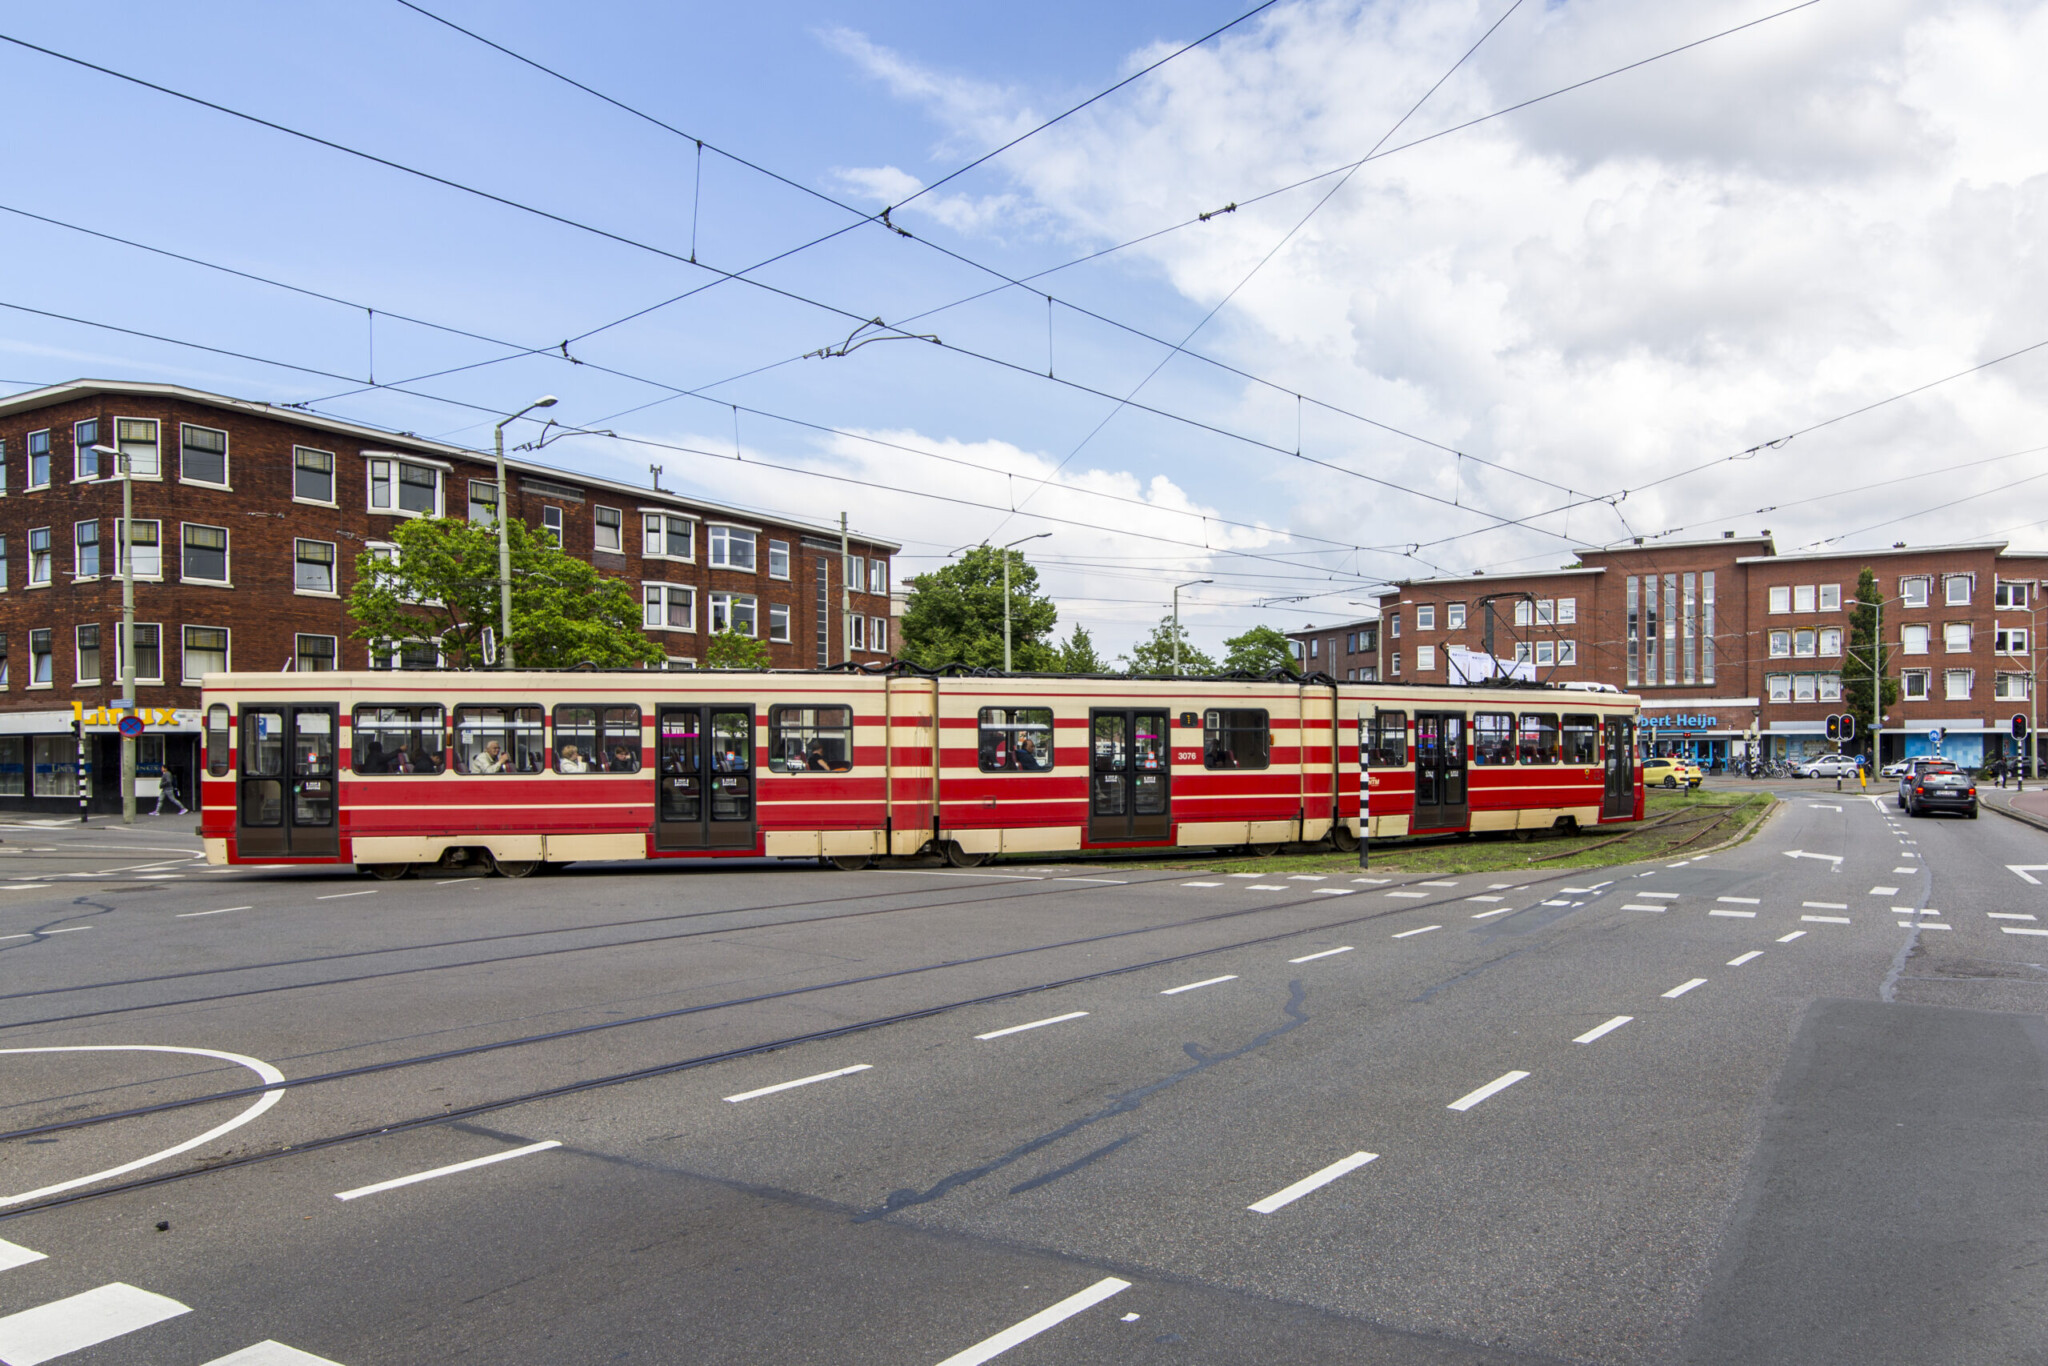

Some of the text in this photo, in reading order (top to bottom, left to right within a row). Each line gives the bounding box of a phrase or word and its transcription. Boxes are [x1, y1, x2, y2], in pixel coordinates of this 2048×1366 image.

[1186, 714, 1191, 724] 1
[1641, 714, 1717, 728] bert Heijn
[1178, 752, 1196, 760] 3076
